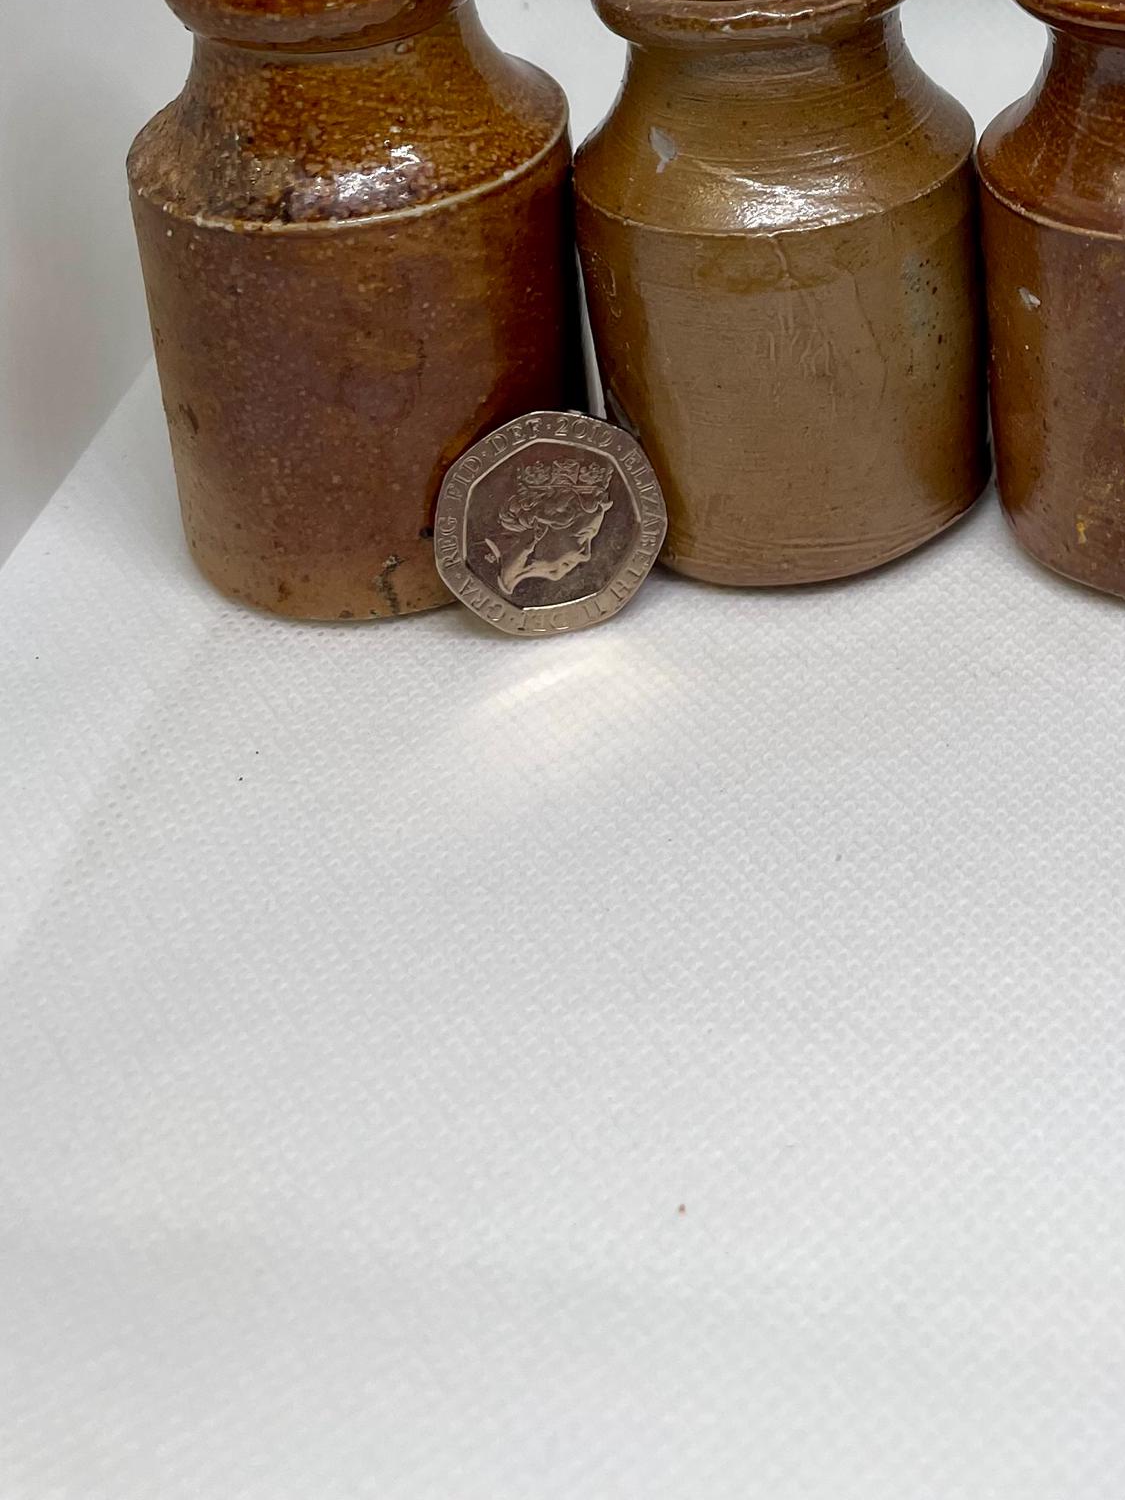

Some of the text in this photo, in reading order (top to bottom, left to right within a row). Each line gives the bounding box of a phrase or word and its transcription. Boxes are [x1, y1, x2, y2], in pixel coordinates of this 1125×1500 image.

[439, 417, 661, 631] ELIZABETH II DEI GRA REG FID DEF 2019
